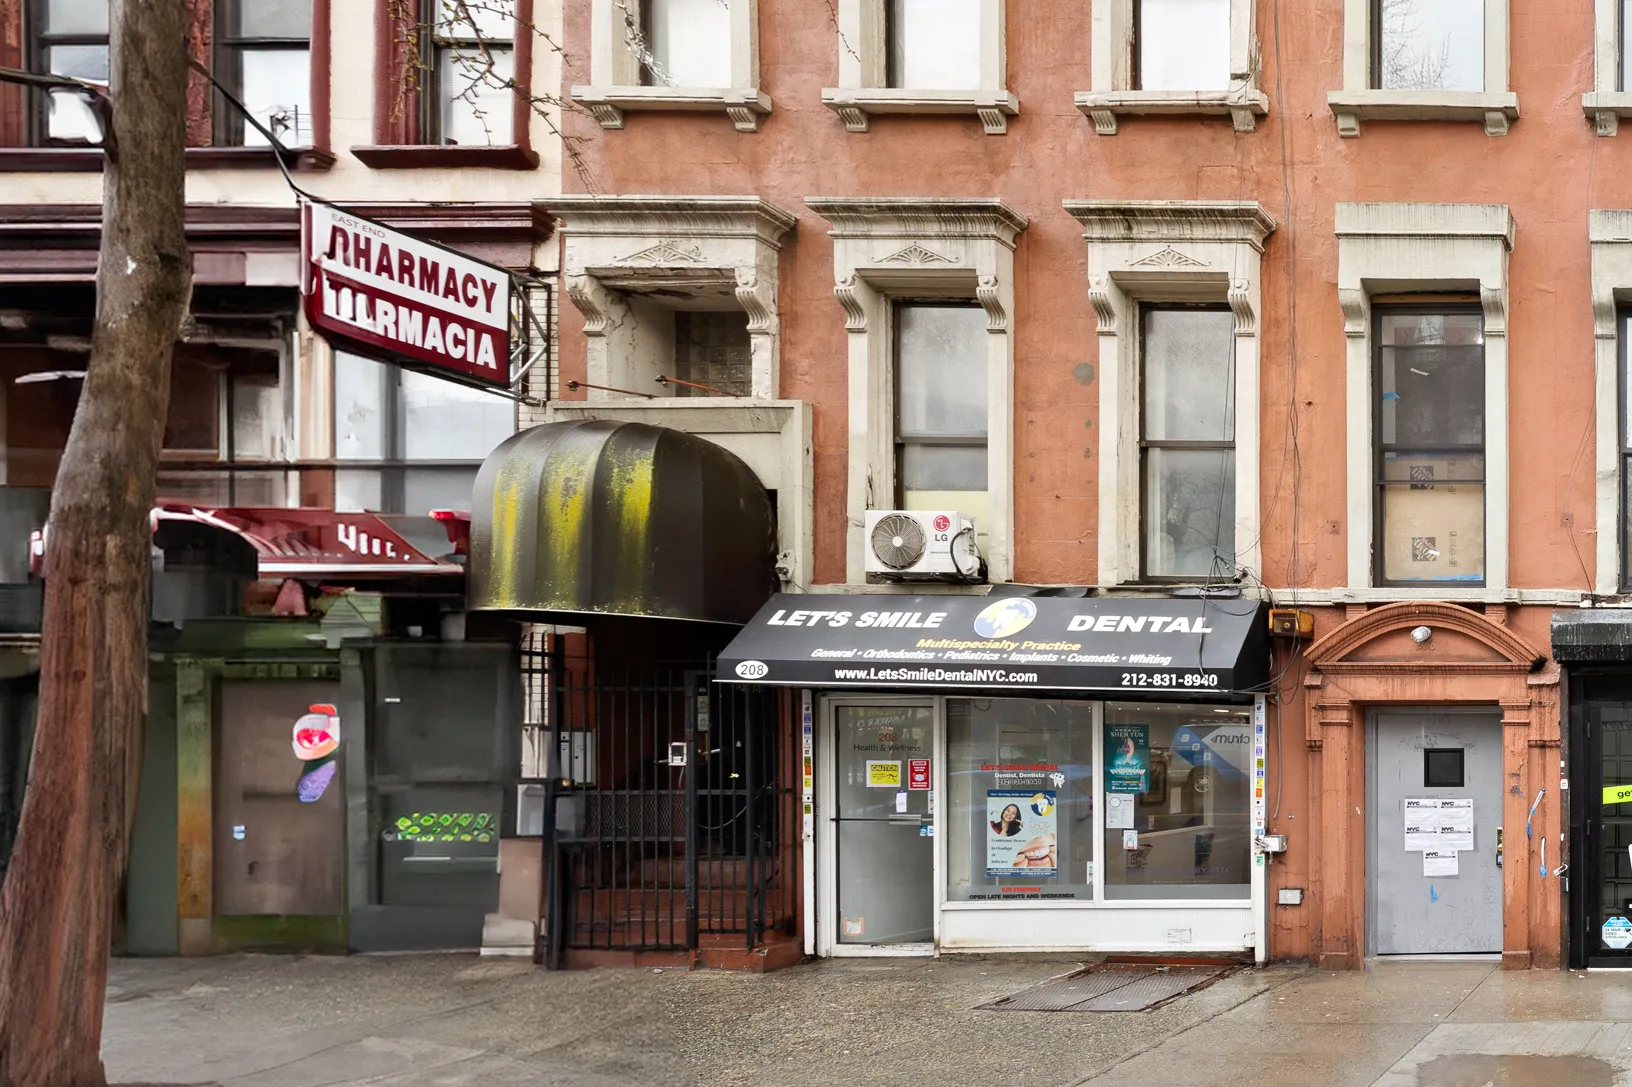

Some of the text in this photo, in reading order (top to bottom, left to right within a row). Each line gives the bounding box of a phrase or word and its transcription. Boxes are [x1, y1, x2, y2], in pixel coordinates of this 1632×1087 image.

[331, 213, 386, 239] EAST END
[934, 533, 948, 542] LG
[766, 609, 1213, 634] LET'S SMILE DENTAL
[915, 638, 1082, 652] Multispecialty Practice
[811, 648, 1173, 666] General Orthodontics Pediatrics Implants Cosmetic Whiting
[740, 664, 764, 676] 208
[834, 667, 1219, 687] www.LetsSmileDentalNYC.com 212-831-8940
[878, 732, 898, 742] 208
[853, 743, 879, 752] Health
[887, 743, 922, 752] Wellness
[871, 764, 899, 772] CAUTION
